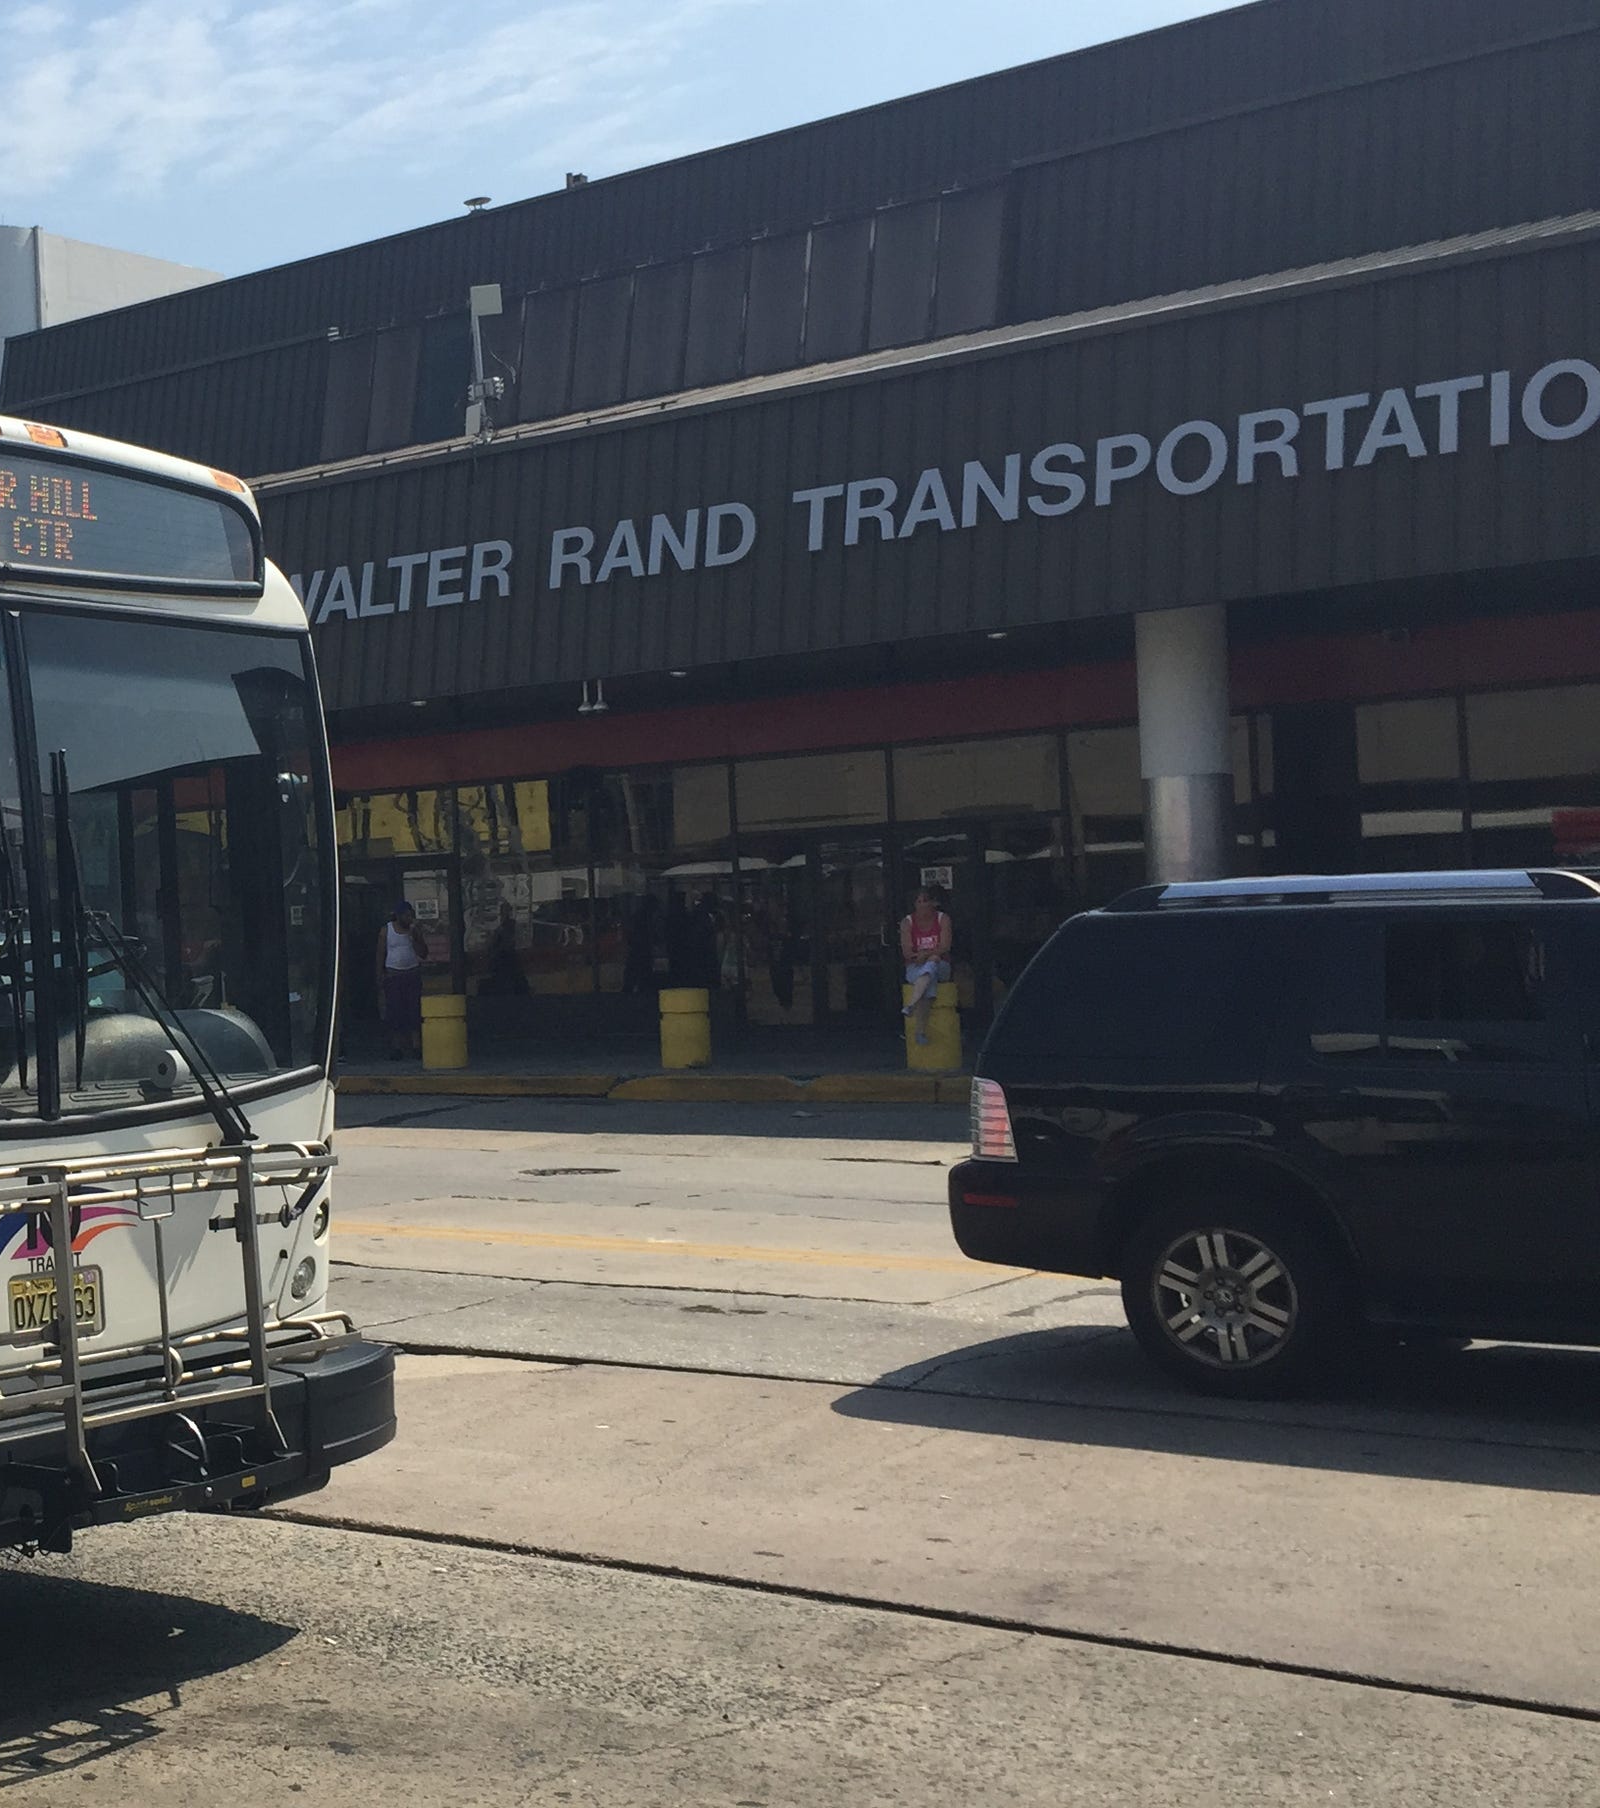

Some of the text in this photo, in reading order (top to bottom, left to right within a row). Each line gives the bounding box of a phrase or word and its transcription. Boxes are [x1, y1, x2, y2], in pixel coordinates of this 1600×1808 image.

[549, 502, 756, 589] RAND
[792, 358, 1600, 552] TRANSPORTATIO
[30, 475, 98, 521] HILL
[13, 515, 73, 560] CTR
[28, 1252, 81, 1273] TRAT
